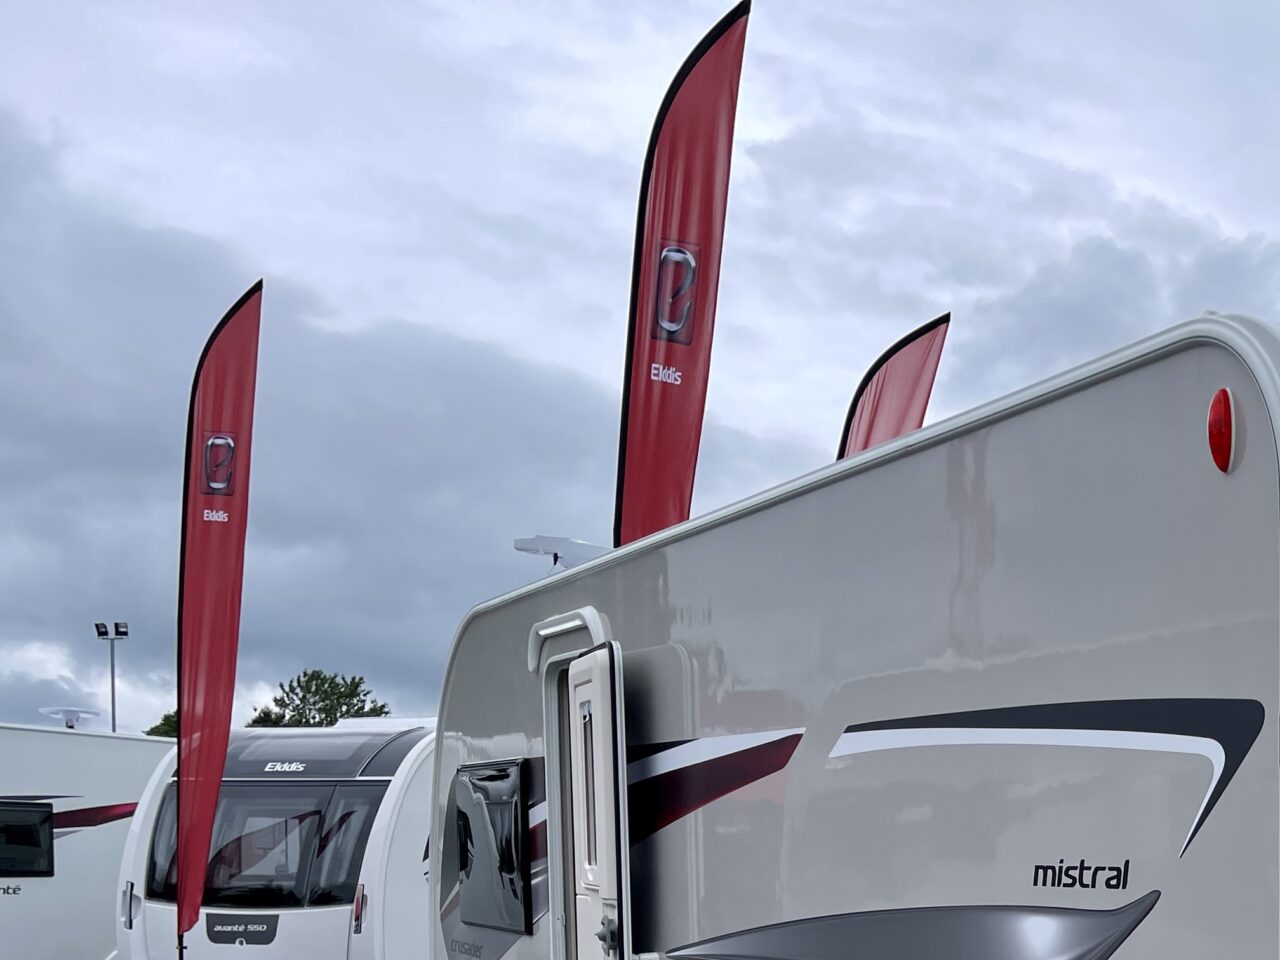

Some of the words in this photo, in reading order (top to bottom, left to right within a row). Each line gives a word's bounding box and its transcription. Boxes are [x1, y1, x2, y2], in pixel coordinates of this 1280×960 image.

[264, 762, 306, 772] Elddis
[1032, 858, 1130, 890] mistral
[451, 939, 483, 959] crusader
